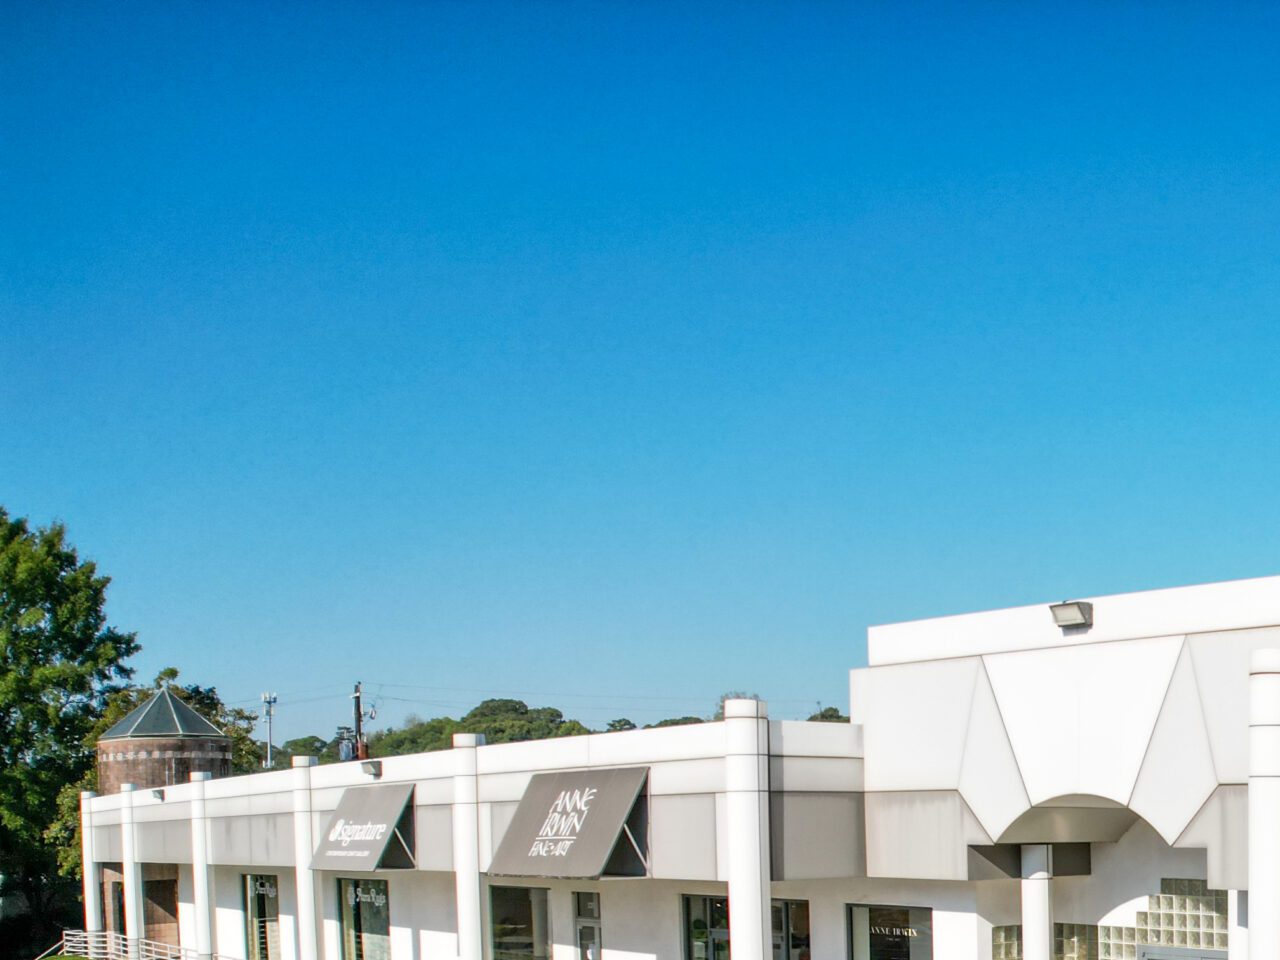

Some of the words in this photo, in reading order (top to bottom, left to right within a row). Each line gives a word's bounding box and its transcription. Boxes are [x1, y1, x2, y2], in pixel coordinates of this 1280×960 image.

[549, 787, 598, 813] ANNE
[338, 820, 387, 847] signature
[539, 810, 588, 836] IRWIN
[870, 925, 890, 936] ANNE
